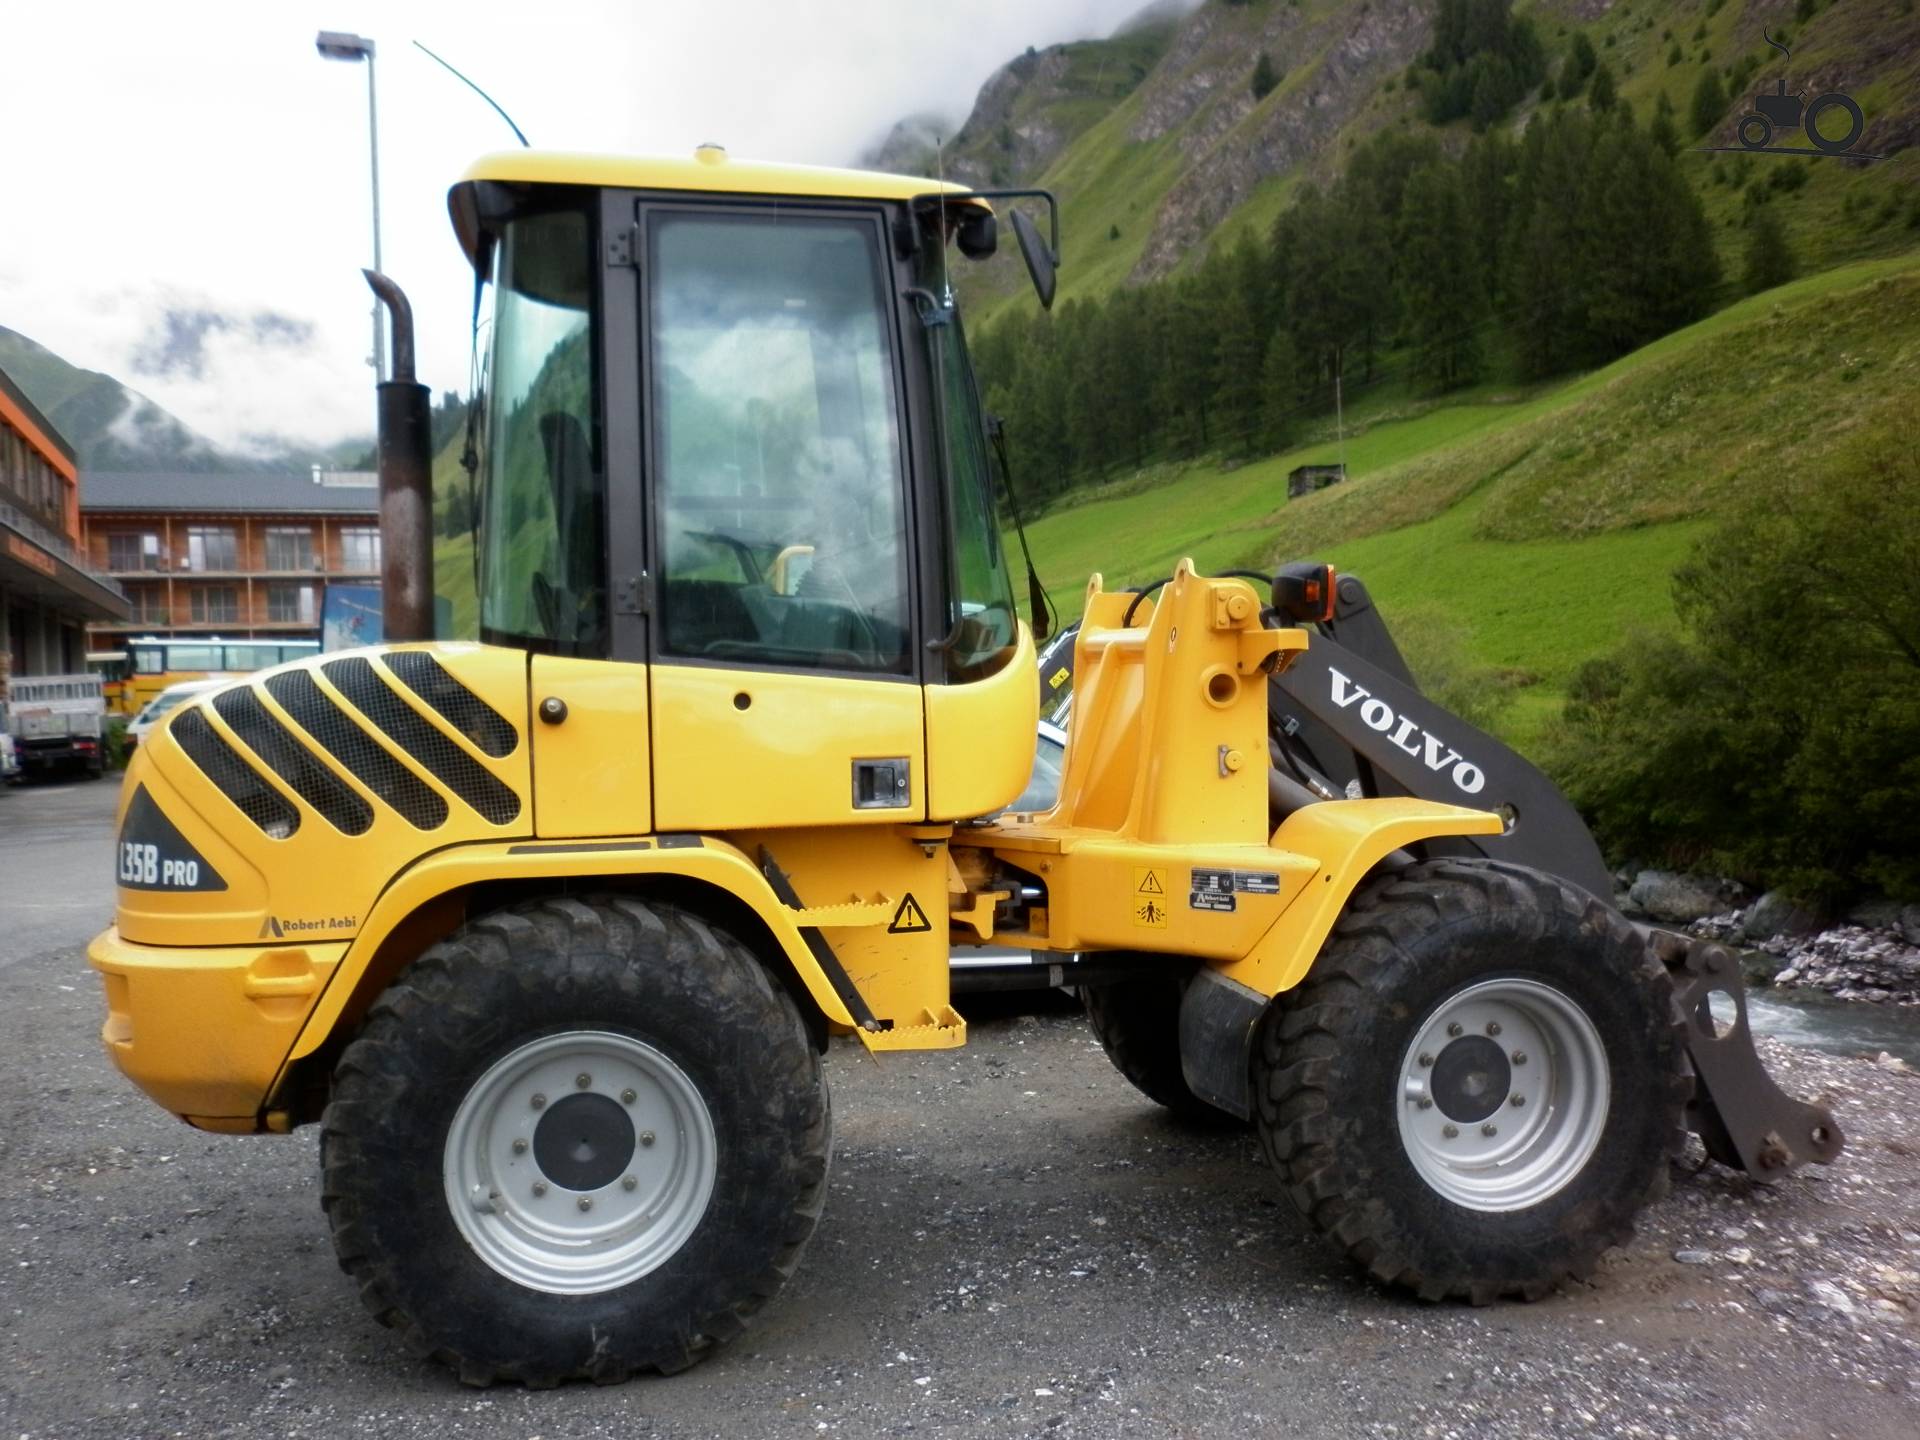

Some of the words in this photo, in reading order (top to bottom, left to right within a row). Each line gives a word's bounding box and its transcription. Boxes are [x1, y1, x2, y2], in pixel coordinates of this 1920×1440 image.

[1328, 666, 1485, 794] VOLVO
[120, 842, 158, 884] L35B
[163, 860, 198, 887] PRO
[283, 919, 326, 931] Robert
[328, 916, 357, 929] Aebi
